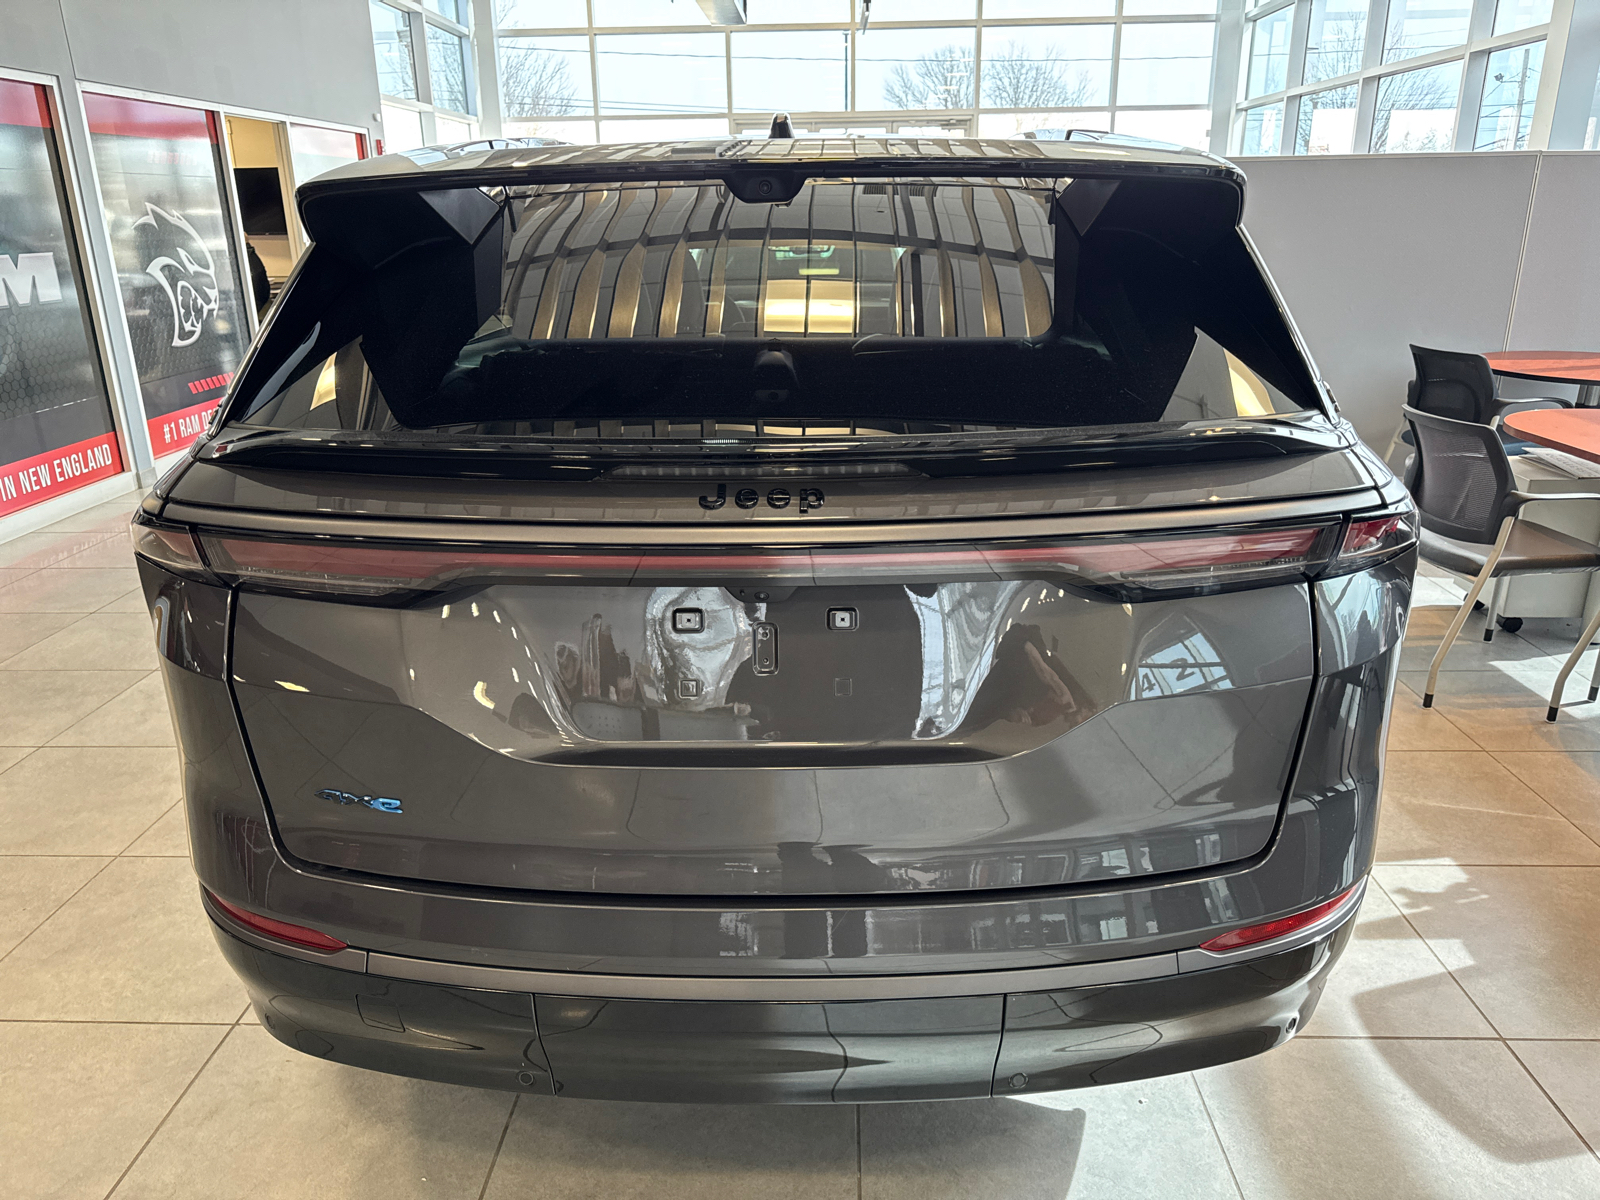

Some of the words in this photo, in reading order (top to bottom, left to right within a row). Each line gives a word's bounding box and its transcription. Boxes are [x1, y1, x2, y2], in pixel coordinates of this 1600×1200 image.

[163, 421, 178, 444] #1
[178, 413, 201, 438] RAM
[0, 475, 17, 502] IN
[18, 463, 51, 495] NEW
[53, 443, 112, 482] ENGLAND
[698, 483, 825, 514] Jeep
